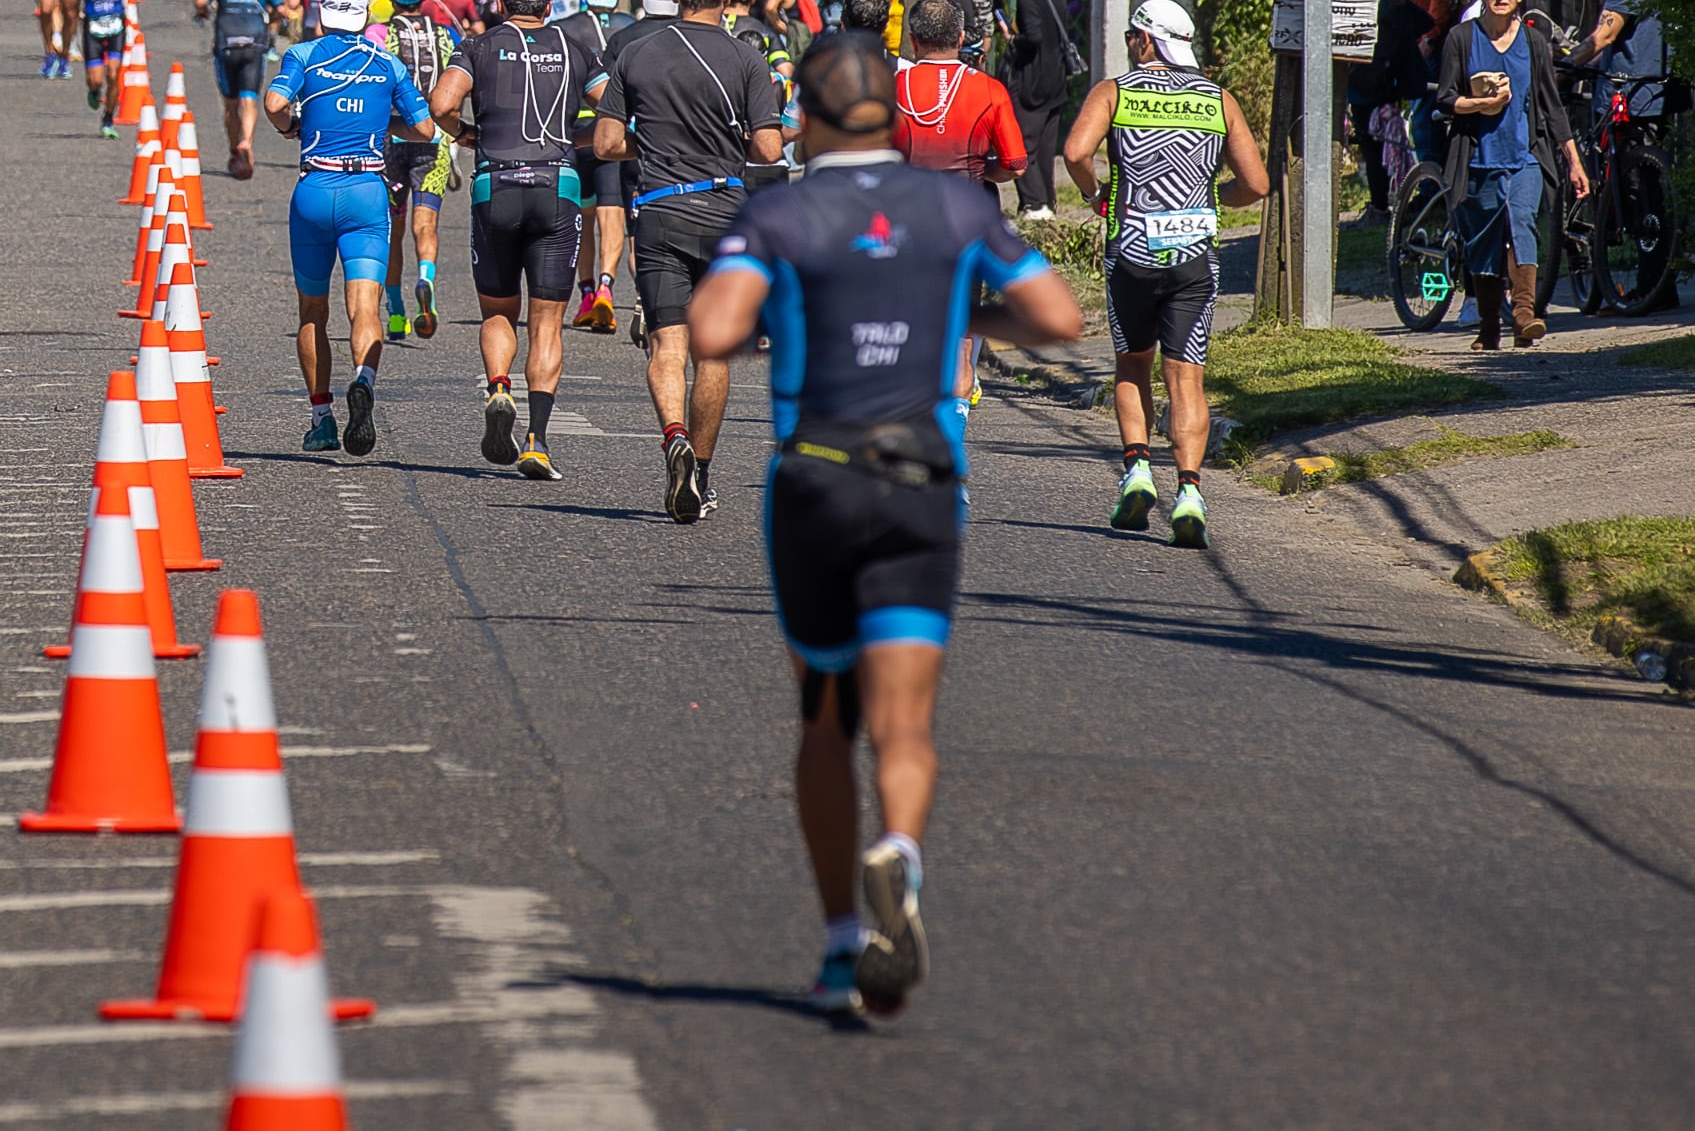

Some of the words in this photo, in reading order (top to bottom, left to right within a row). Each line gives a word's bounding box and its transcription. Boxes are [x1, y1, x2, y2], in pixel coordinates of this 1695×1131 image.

[536, 63, 563, 73] Team
[335, 97, 364, 114] CHI
[1153, 217, 1211, 236] 1484
